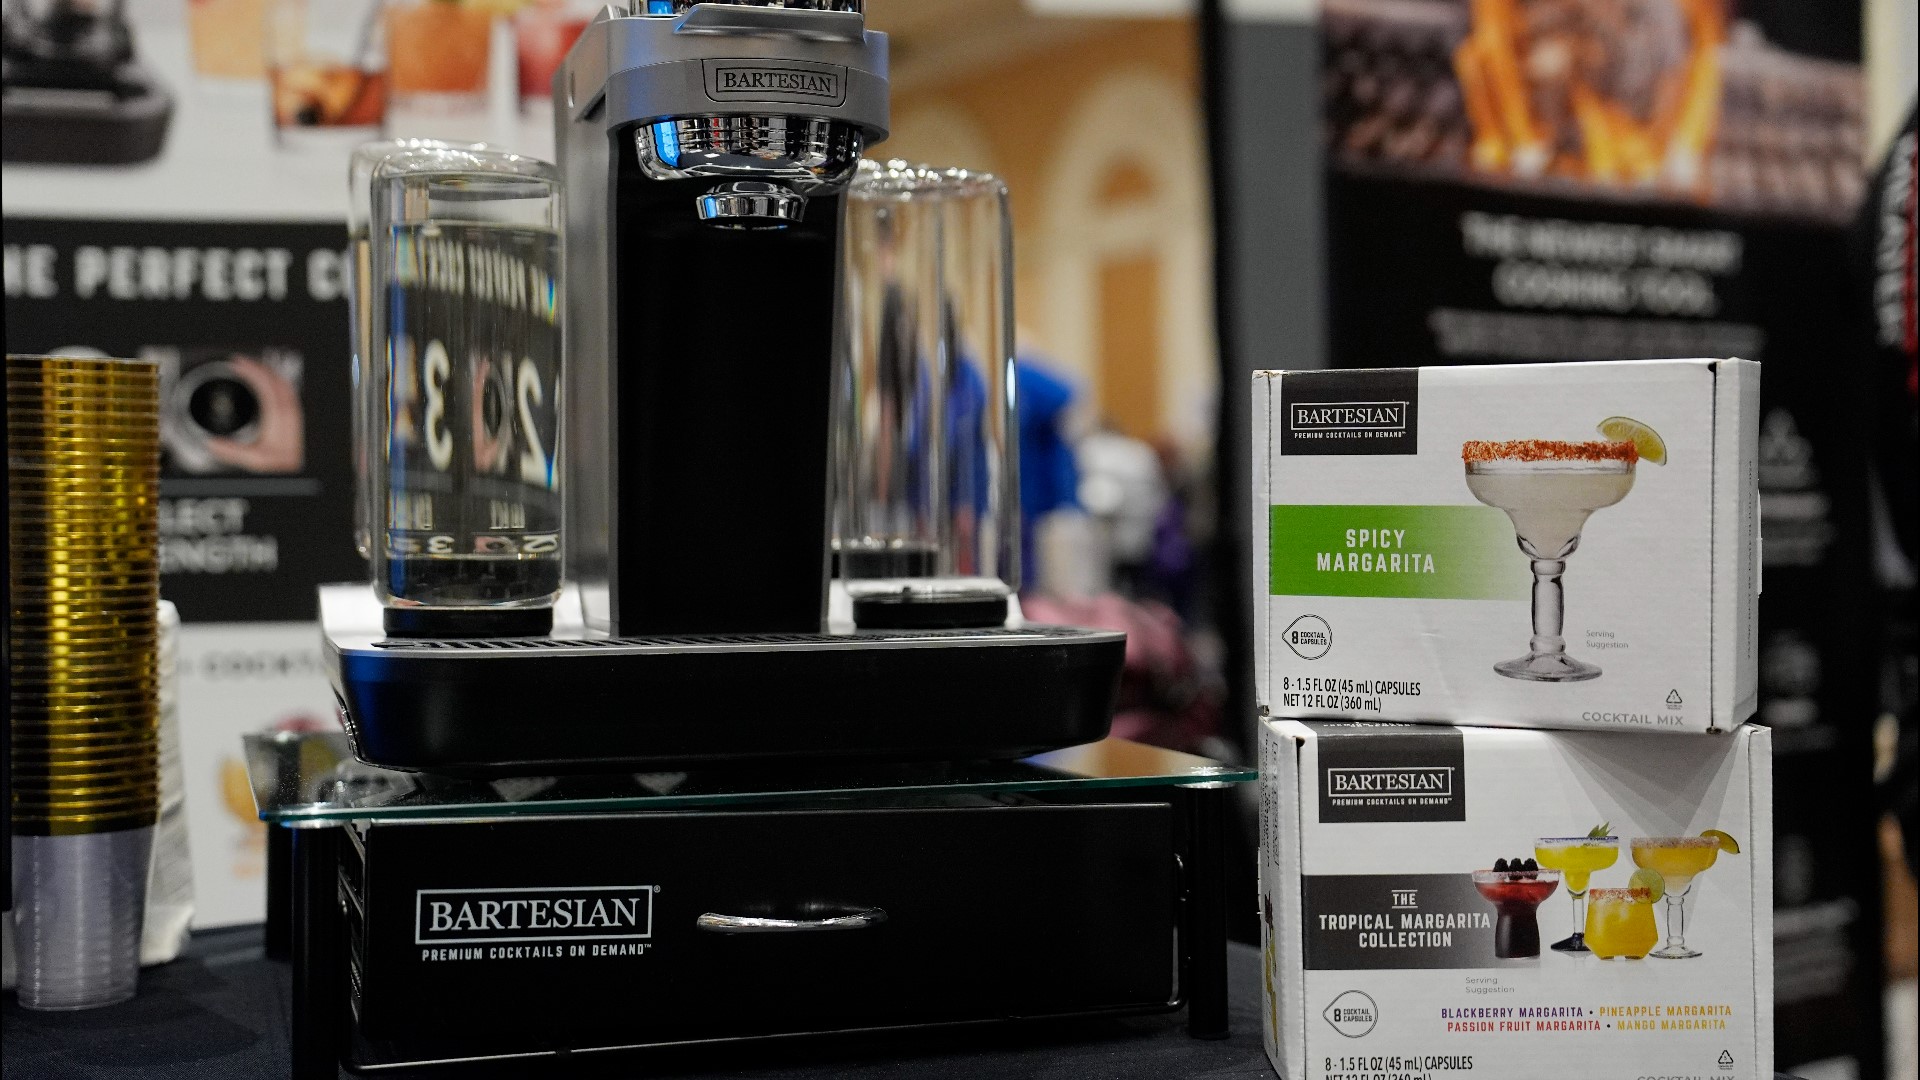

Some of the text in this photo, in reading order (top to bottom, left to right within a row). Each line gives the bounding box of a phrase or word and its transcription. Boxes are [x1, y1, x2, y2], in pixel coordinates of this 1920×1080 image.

[723, 71, 832, 94] BARTESIAN
[74, 246, 293, 301] PERFECT
[1297, 407, 1400, 425] BARTESIAN
[1326, 431, 1362, 439] COCKTAILS
[1345, 529, 1406, 549] SPICY
[1316, 552, 1436, 574] MARGARITA
[1291, 631, 1325, 645] 8 COCKTAIL
[1300, 638, 1328, 646] CAPSULES
[1586, 629, 1615, 640] Serving
[1586, 640, 1629, 650] Suggestion
[1283, 676, 1290, 691] 8
[1296, 677, 1311, 692] 1.5
[1313, 678, 1323, 692] FL
[1324, 678, 1337, 693] OZ
[1338, 679, 1354, 695] (45
[1356, 680, 1373, 696] mL)
[1375, 680, 1421, 696] CAPSULES
[1283, 693, 1382, 713] NET 12 FL OZ (360 mL)
[1582, 711, 1684, 726] COCKTAIL MIX
[1335, 772, 1445, 791] BARTESIAN
[1332, 798, 1364, 806] PREMIUM
[1366, 798, 1405, 806] COCKTAILS
[1392, 892, 1416, 906] THE
[429, 897, 641, 931] BARTESIAN
[1319, 912, 1491, 930] TROPICAL MARGARITA
[1358, 931, 1452, 948] COLLECTION
[422, 948, 483, 961] PREMIUM
[489, 946, 563, 959] COCKTAILS
[569, 945, 586, 957] ON
[1465, 976, 1498, 985] Serving
[1465, 985, 1515, 995] Suggestion
[1333, 1008, 1342, 1022] 8
[1441, 1005, 1732, 1019] BLACKBERRY MARGARITA PINEAPPLE MARGARITA
[1447, 1019, 1726, 1032] PASSION FRUIT MARGARITA MANGO MARGARITA
[1325, 1056, 1332, 1071] 8
[1340, 1057, 1355, 1071] 1.5
[1358, 1057, 1369, 1071] FL
[1370, 1056, 1383, 1071] OZ
[1385, 1056, 1402, 1073] (45
[1404, 1056, 1423, 1073] mL)
[1425, 1055, 1473, 1070] CAPSULES
